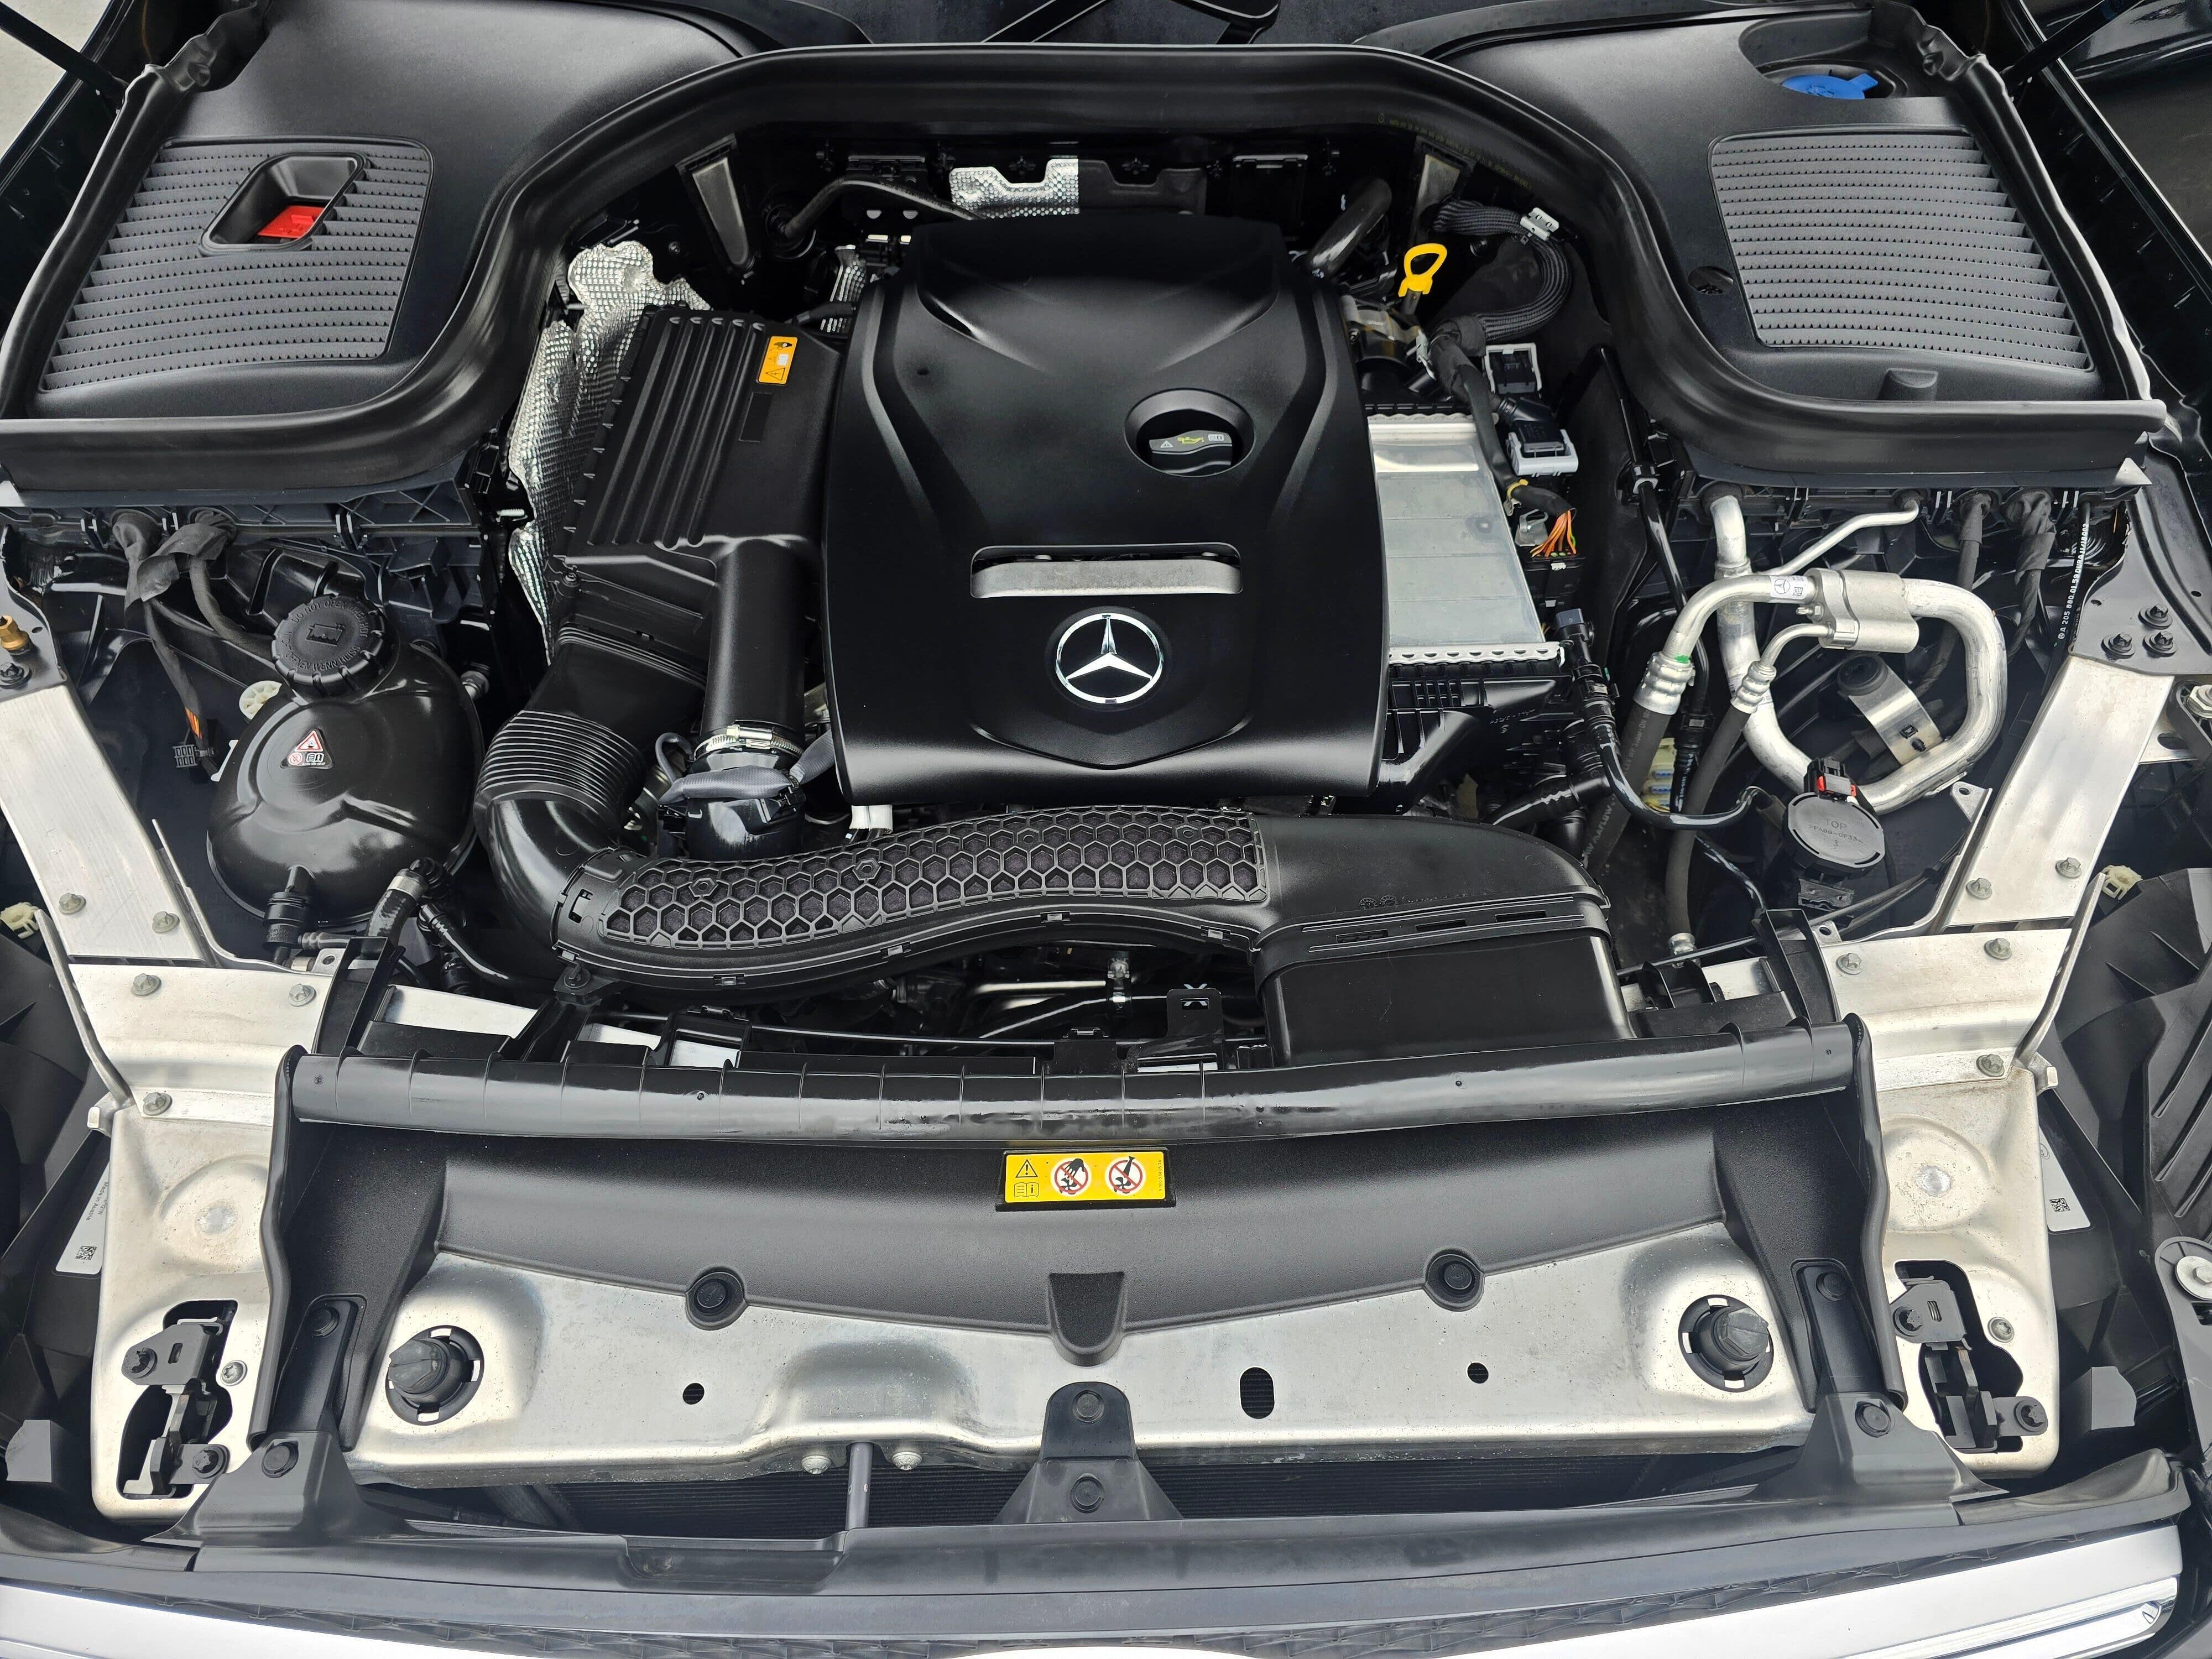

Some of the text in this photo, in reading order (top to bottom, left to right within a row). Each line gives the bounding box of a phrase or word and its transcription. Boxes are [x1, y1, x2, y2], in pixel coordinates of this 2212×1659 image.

[2062, 611, 2070, 625] 205
[2066, 595, 2074, 609] 880
[291, 600, 369, 638] DO NOT OPEN WHEN HOT
[312, 659, 338, 671] WENN
[1825, 818, 1848, 830] TOP
[98, 1182, 109, 1196] Made
[86, 1203, 98, 1220] Austria
